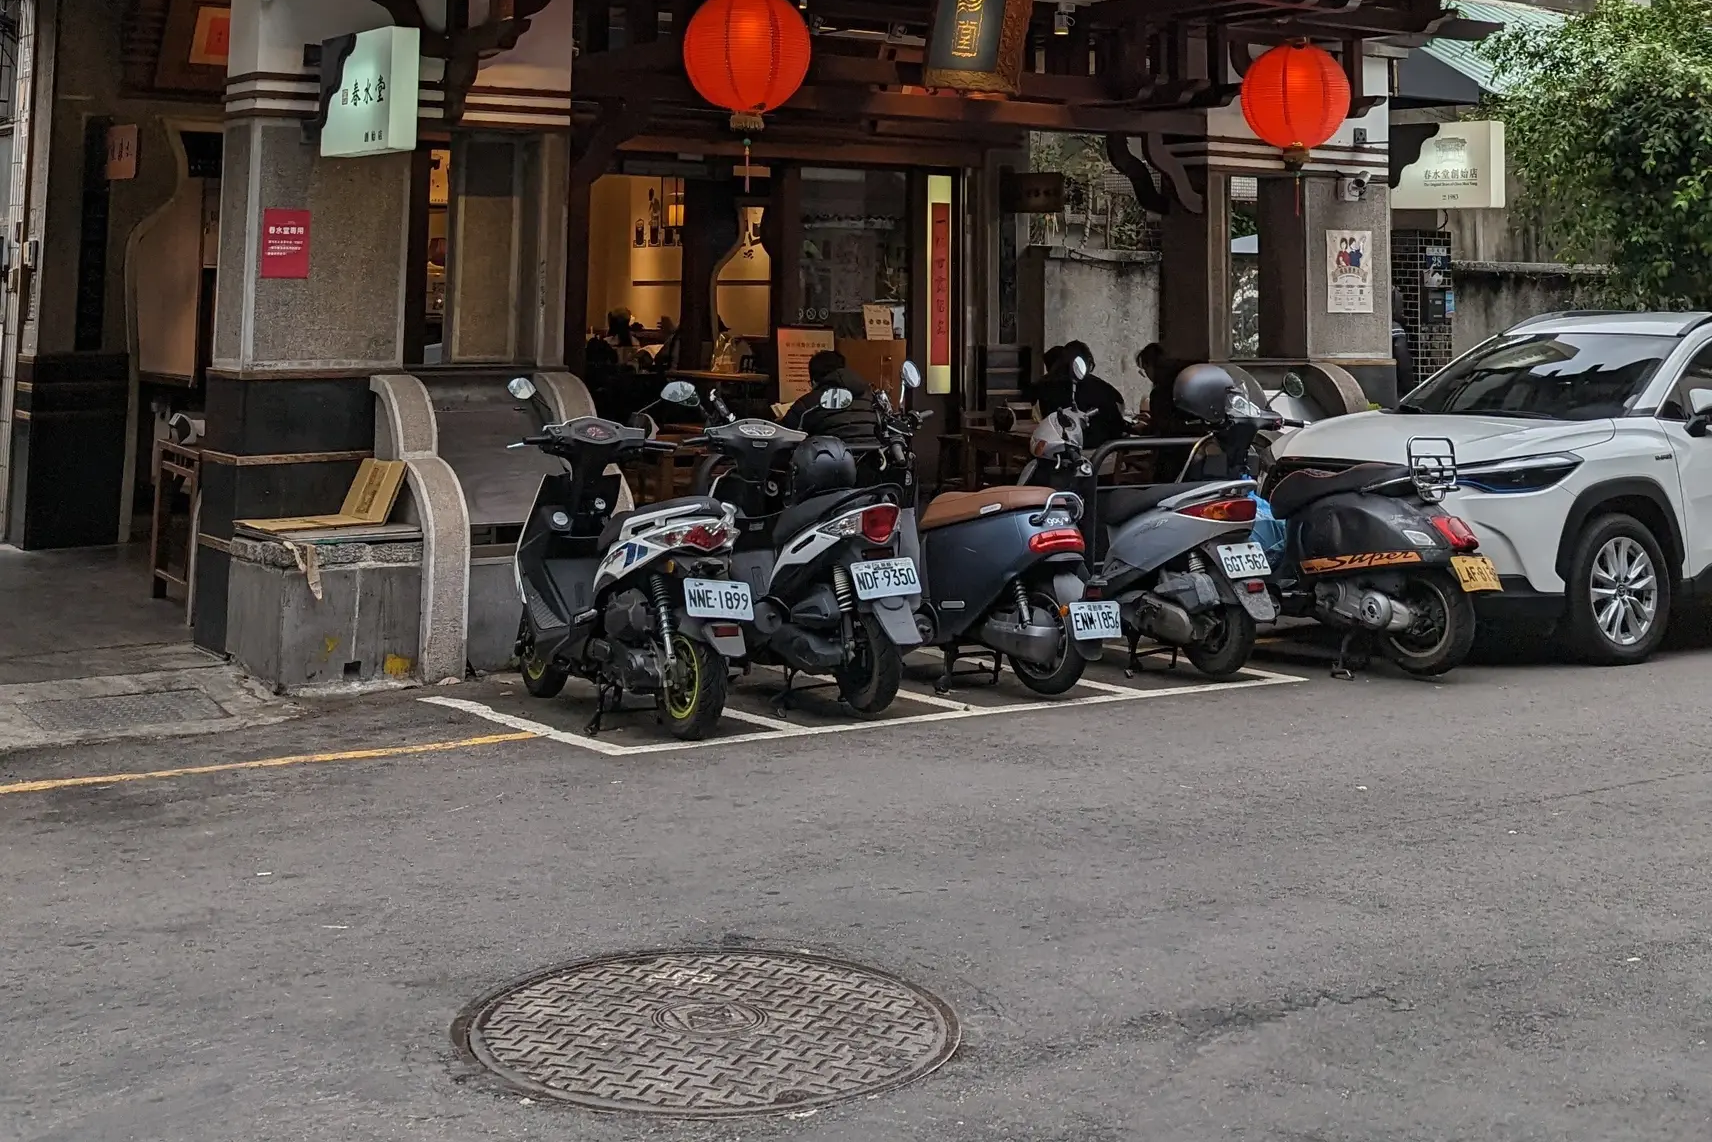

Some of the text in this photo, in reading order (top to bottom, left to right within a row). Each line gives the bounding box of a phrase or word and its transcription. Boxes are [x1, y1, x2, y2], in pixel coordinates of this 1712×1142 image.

[351, 74, 386, 107] 春水堂
[1424, 168, 1478, 179] 春水堂創始店
[1432, 256, 1442, 267] 28
[1308, 551, 1413, 570] Super
